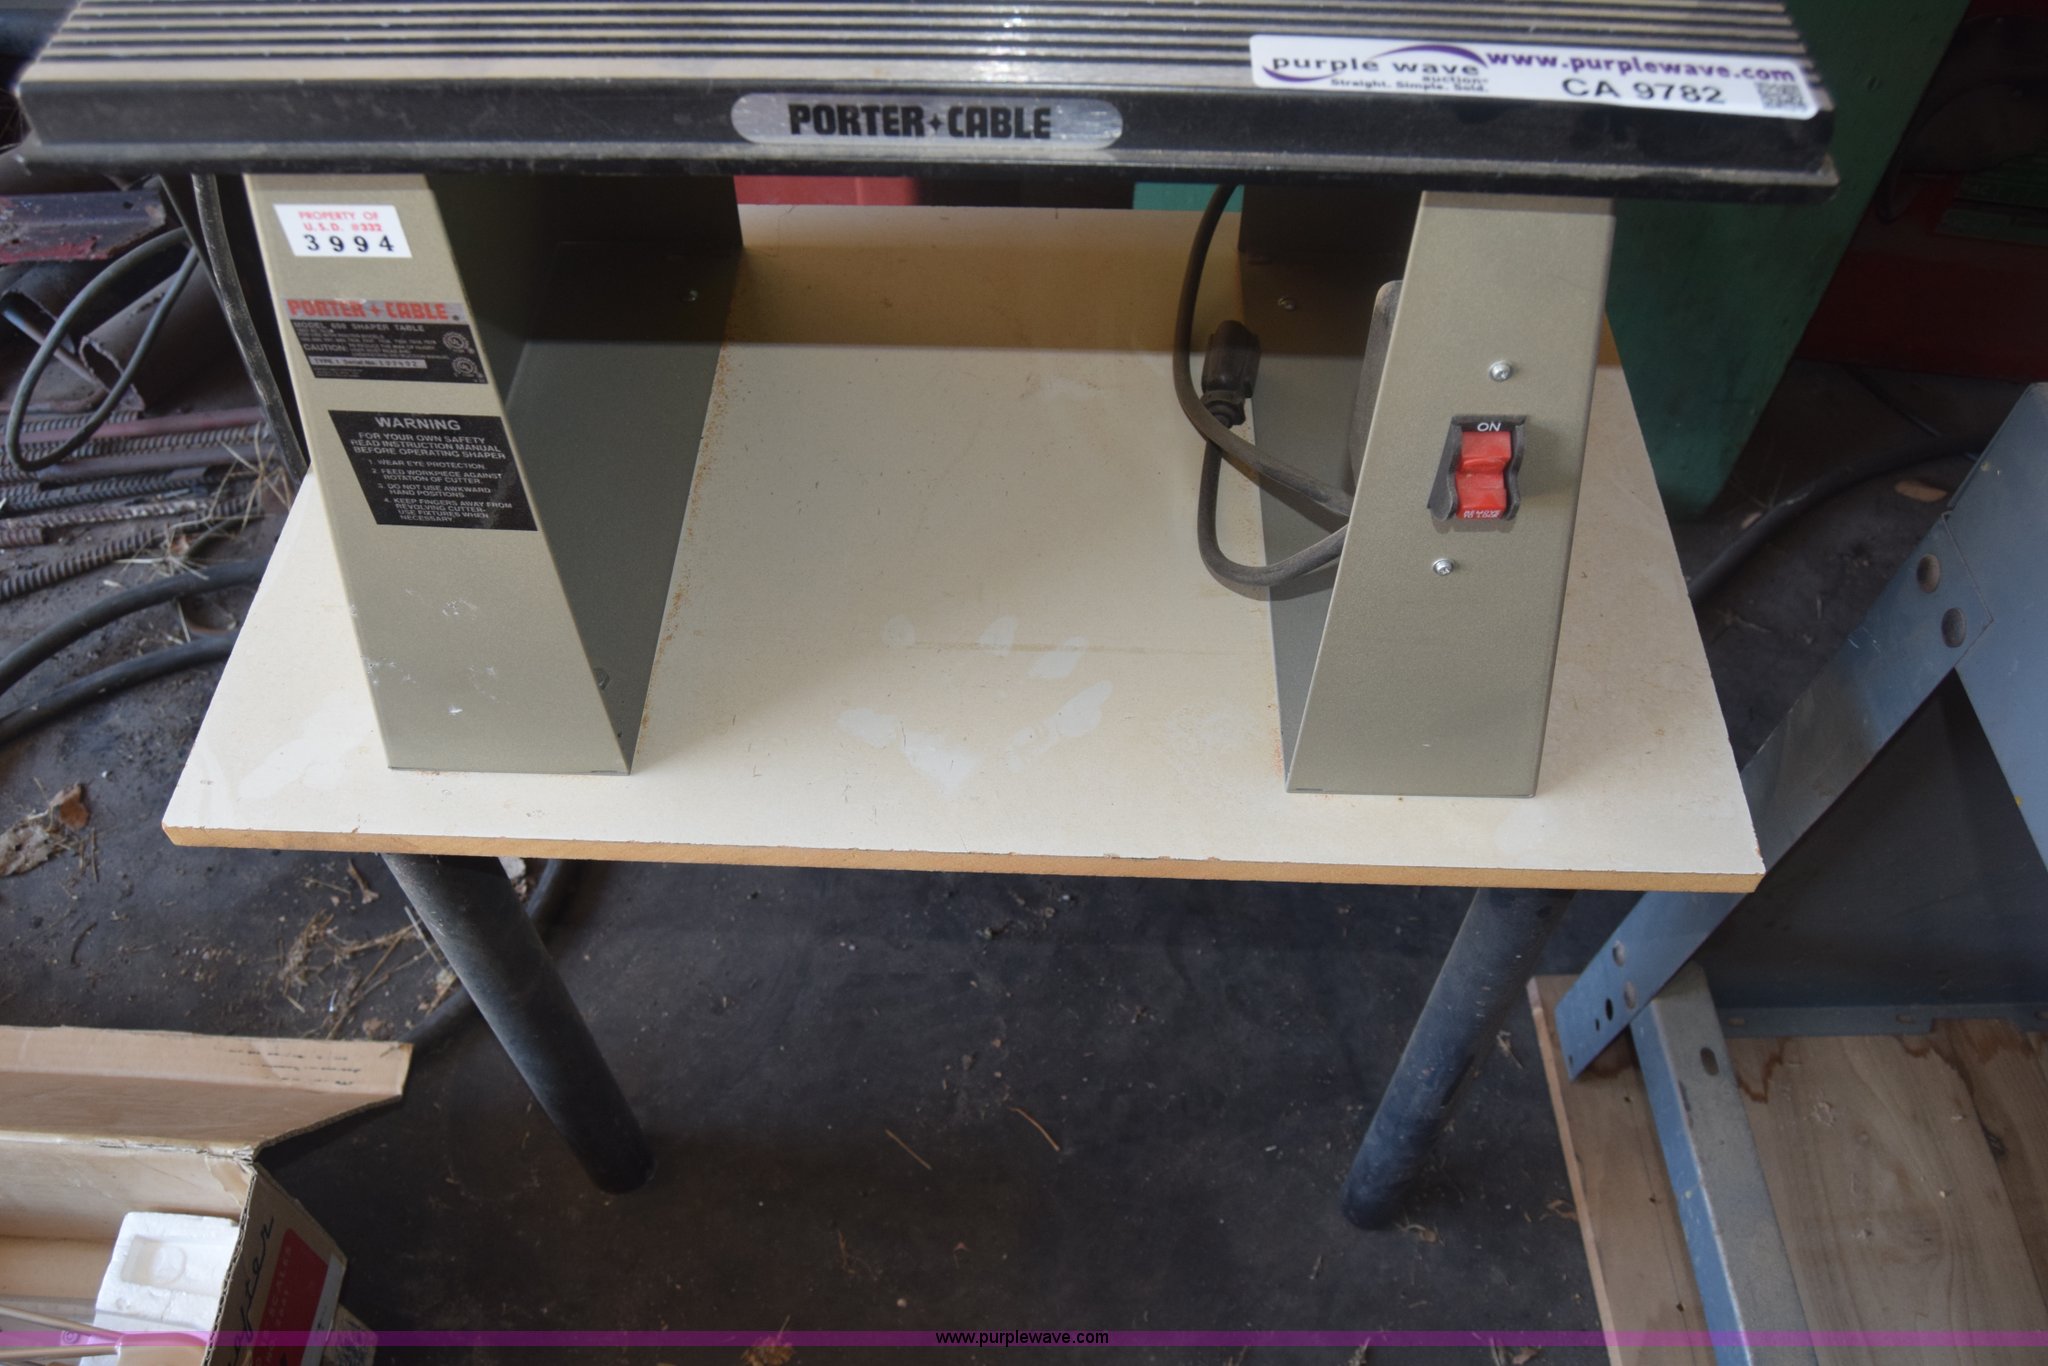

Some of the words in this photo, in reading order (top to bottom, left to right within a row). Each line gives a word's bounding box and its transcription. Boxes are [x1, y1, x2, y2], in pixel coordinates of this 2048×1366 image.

[1272, 57, 1379, 72] purple
[1393, 62, 1479, 75] wave
[1486, 53, 1795, 81] www.purplewave.com
[1562, 78, 1620, 98] CA
[1633, 82, 1726, 104] 9782
[298, 211, 354, 219] PROPERTY
[363, 212, 378, 220] OF
[304, 234, 394, 252] 3994
[374, 417, 461, 431] WARNING
[1477, 422, 1502, 432] ON
[382, 441, 453, 449] INSTRUCTION
[455, 444, 501, 452] MANUAL
[398, 449, 460, 457] OPERATING
[407, 469, 461, 477] WORKPIECE
